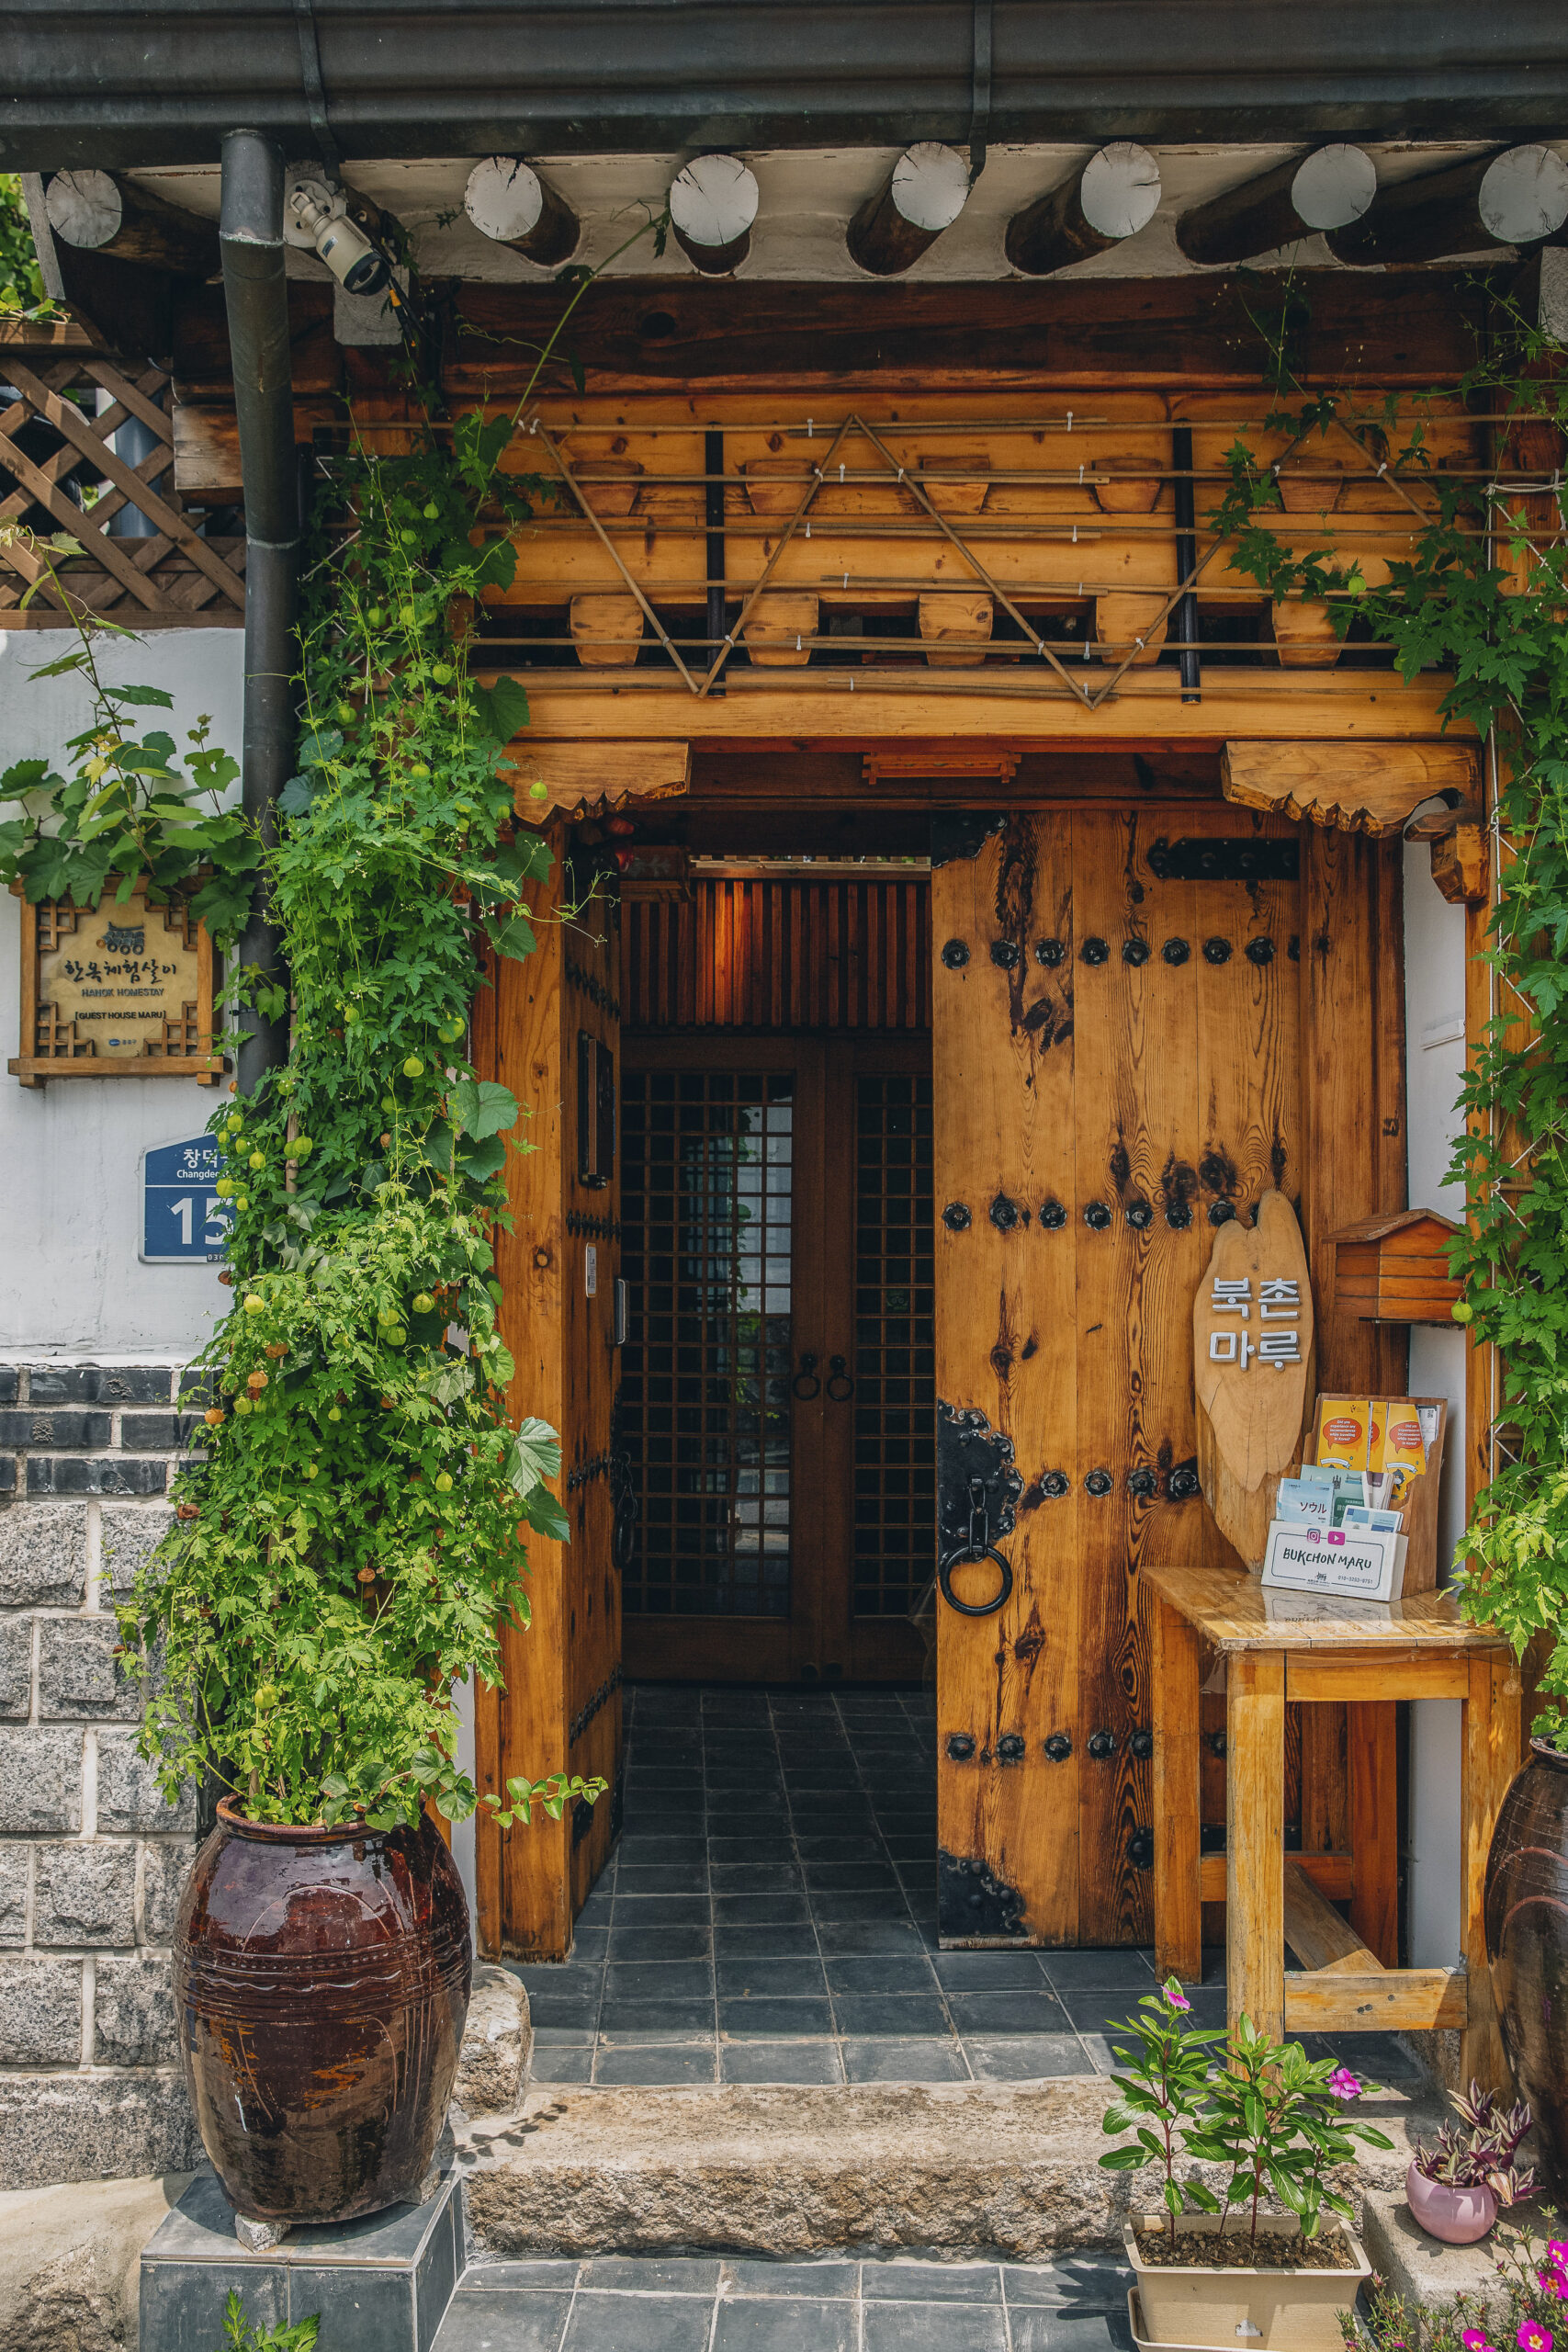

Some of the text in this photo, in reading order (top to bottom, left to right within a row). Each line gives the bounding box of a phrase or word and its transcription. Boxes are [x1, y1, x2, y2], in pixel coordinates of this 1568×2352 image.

[81, 988, 164, 998] HANOK HOMESTAY
[75, 1012, 107, 1020] [GUEST
[139, 1011, 166, 1020] MARU]
[1211, 1277, 1301, 1322] 북촌
[1209, 1329, 1302, 1373] 마루
[1300, 1501, 1327, 1514] ソウル
[1282, 1547, 1372, 1571] BUKCHON MARU
